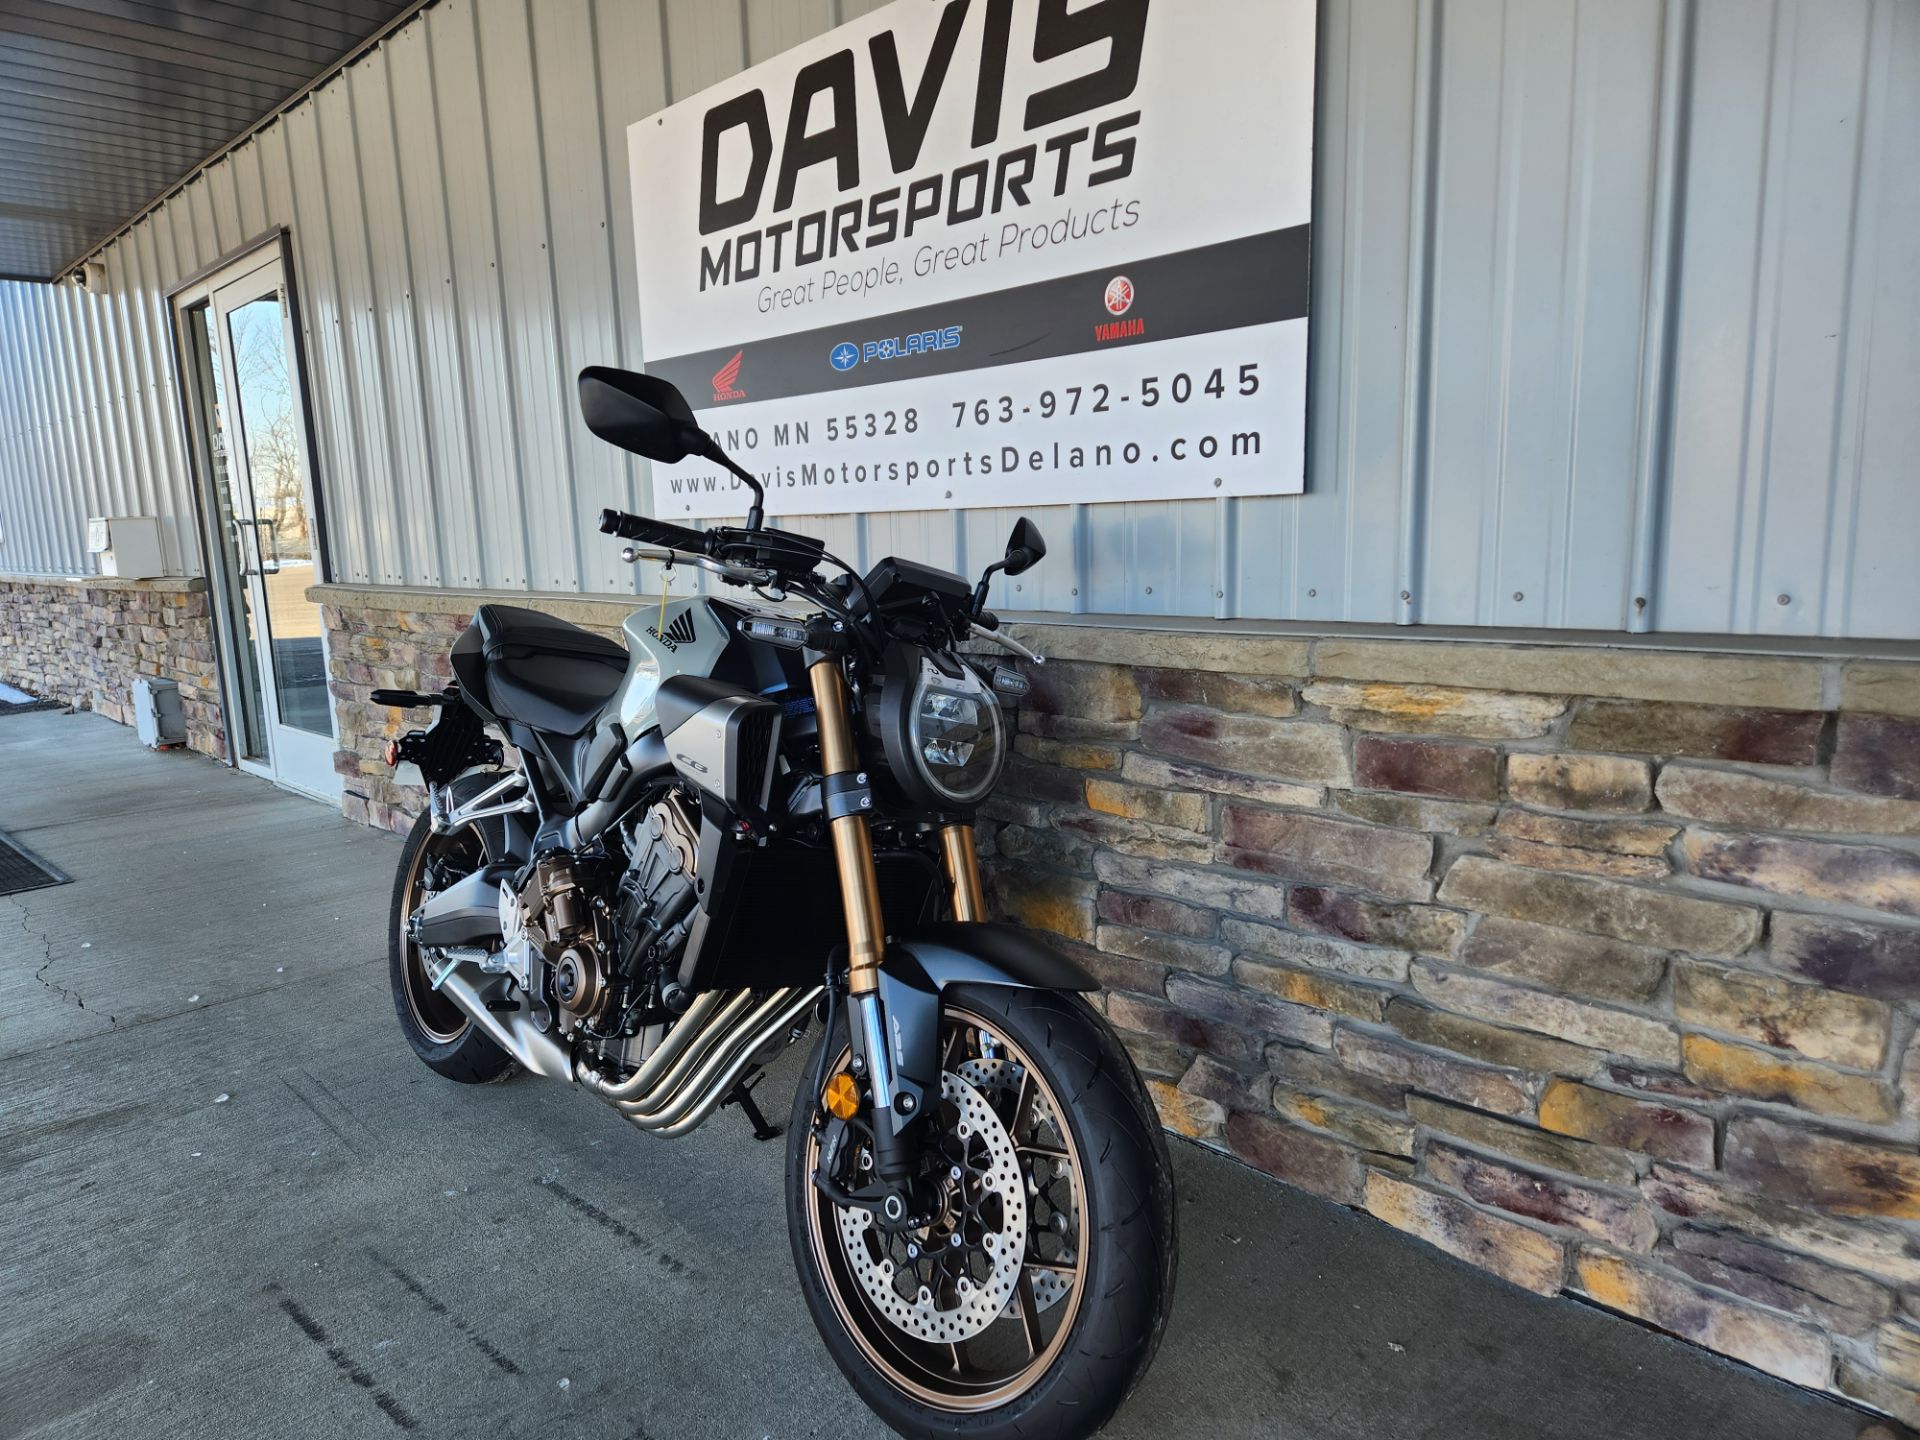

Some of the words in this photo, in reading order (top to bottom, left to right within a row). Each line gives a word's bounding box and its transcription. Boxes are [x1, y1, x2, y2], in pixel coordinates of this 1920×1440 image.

[699, 0, 1150, 236] DAVIS
[699, 110, 1142, 292] MOTORSPORTS
[757, 279, 815, 313] Great
[821, 257, 904, 298] People,
[914, 232, 990, 278] Great
[998, 198, 1141, 258] Products
[863, 326, 961, 362] POLARIS
[1094, 318, 1145, 342] YAMAHA
[712, 389, 747, 402] HONDA
[773, 421, 810, 447] MN
[826, 407, 919, 441] 55328
[951, 363, 1260, 428] 763-972-5045
